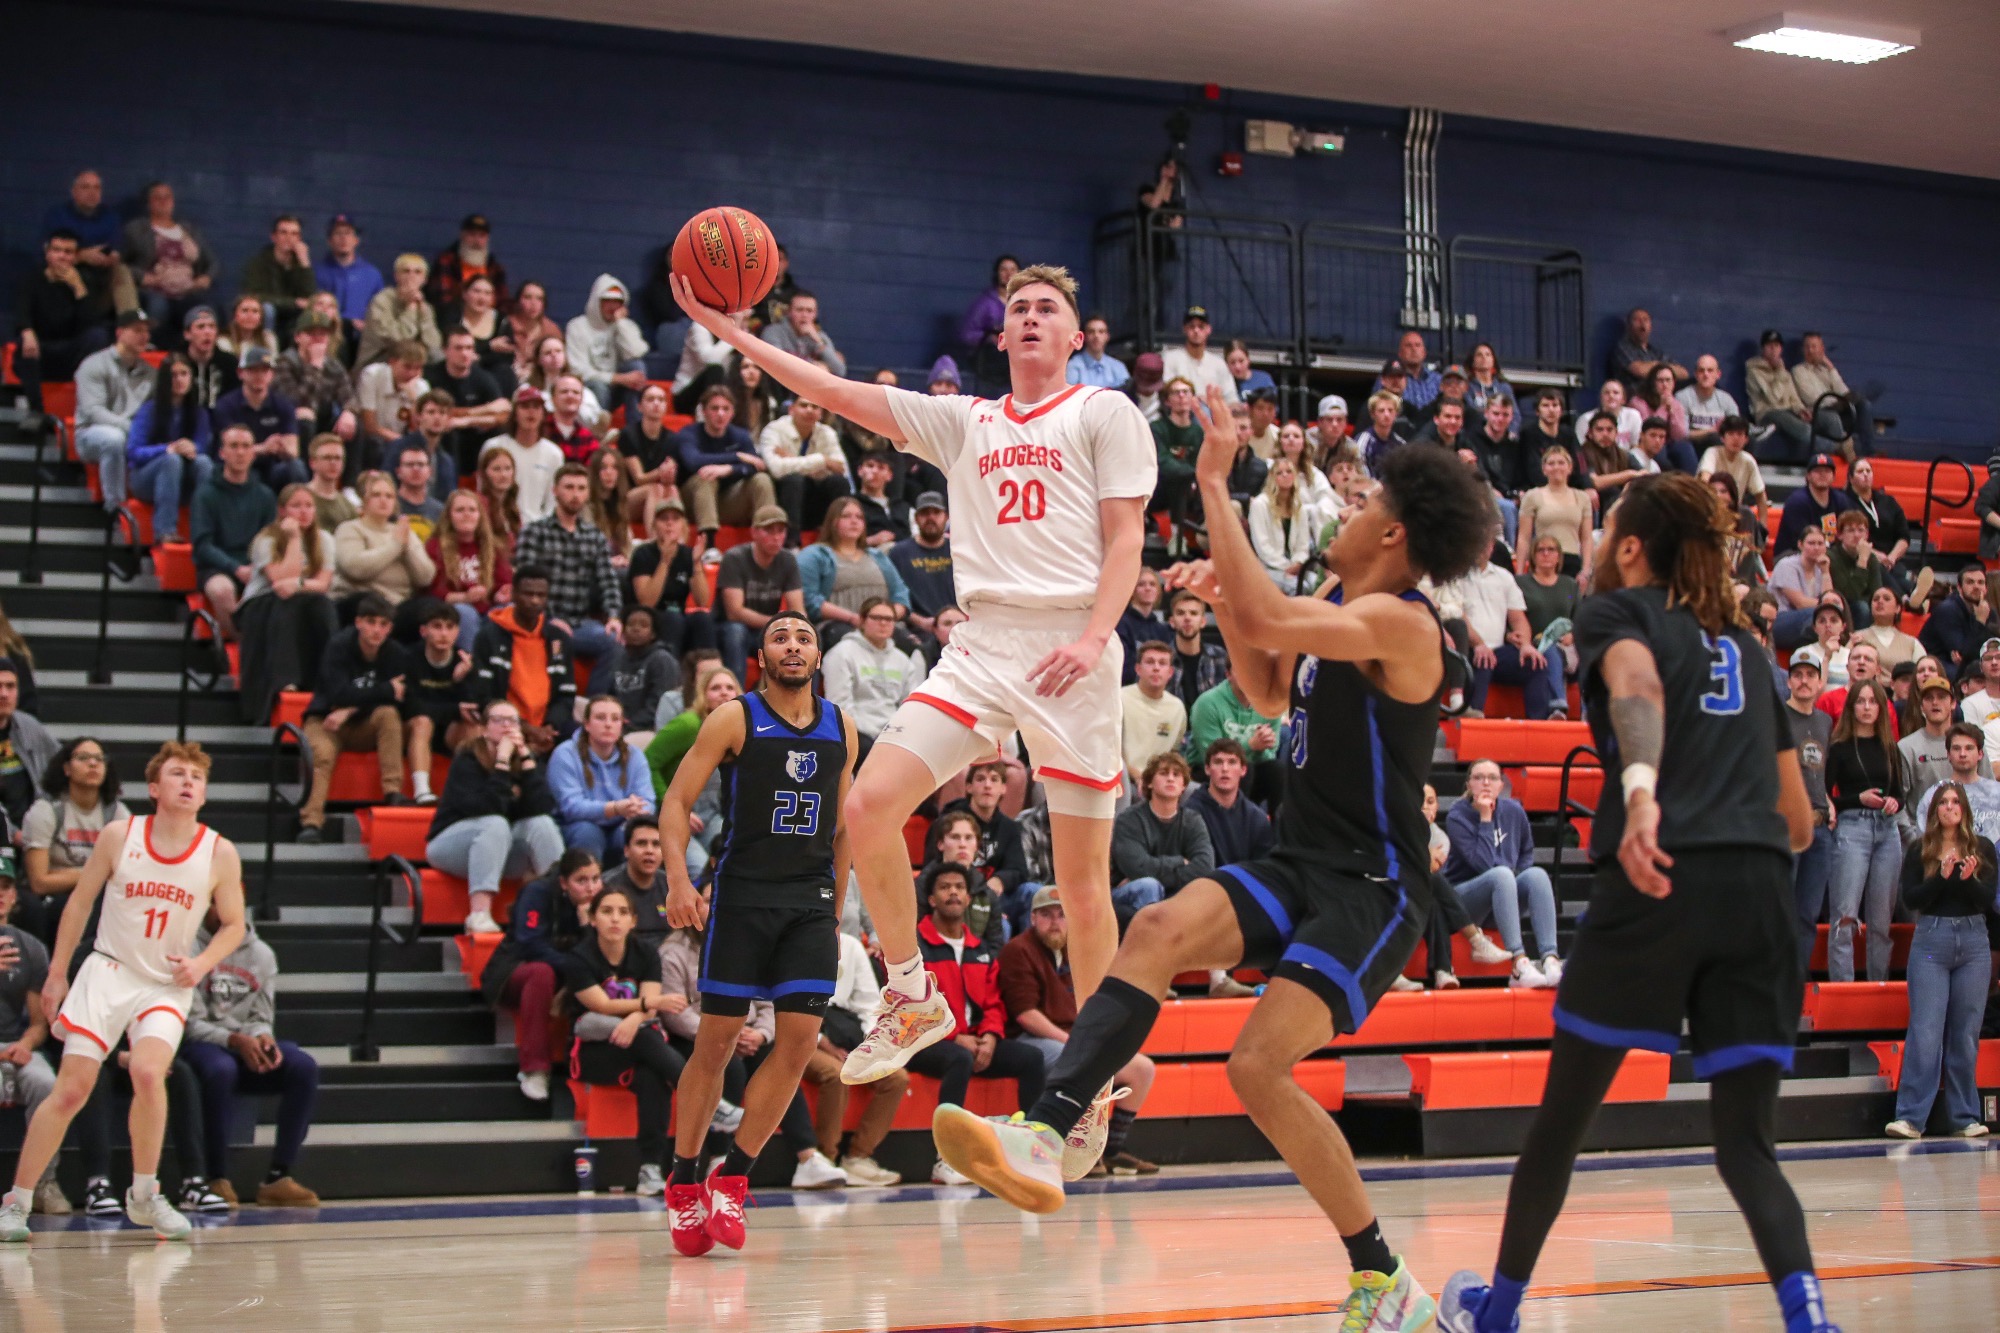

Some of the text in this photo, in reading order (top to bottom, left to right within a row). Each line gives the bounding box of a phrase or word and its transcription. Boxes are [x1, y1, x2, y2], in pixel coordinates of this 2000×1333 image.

[706, 215, 730, 269] LEGACY
[978, 444, 1063, 479] BADGERS
[998, 477, 1046, 526] 20
[1698, 631, 1746, 714] 3
[771, 791, 821, 836] 23
[125, 881, 195, 910] BADGERS
[144, 908, 169, 939] 11
[526, 910, 539, 928] 3
